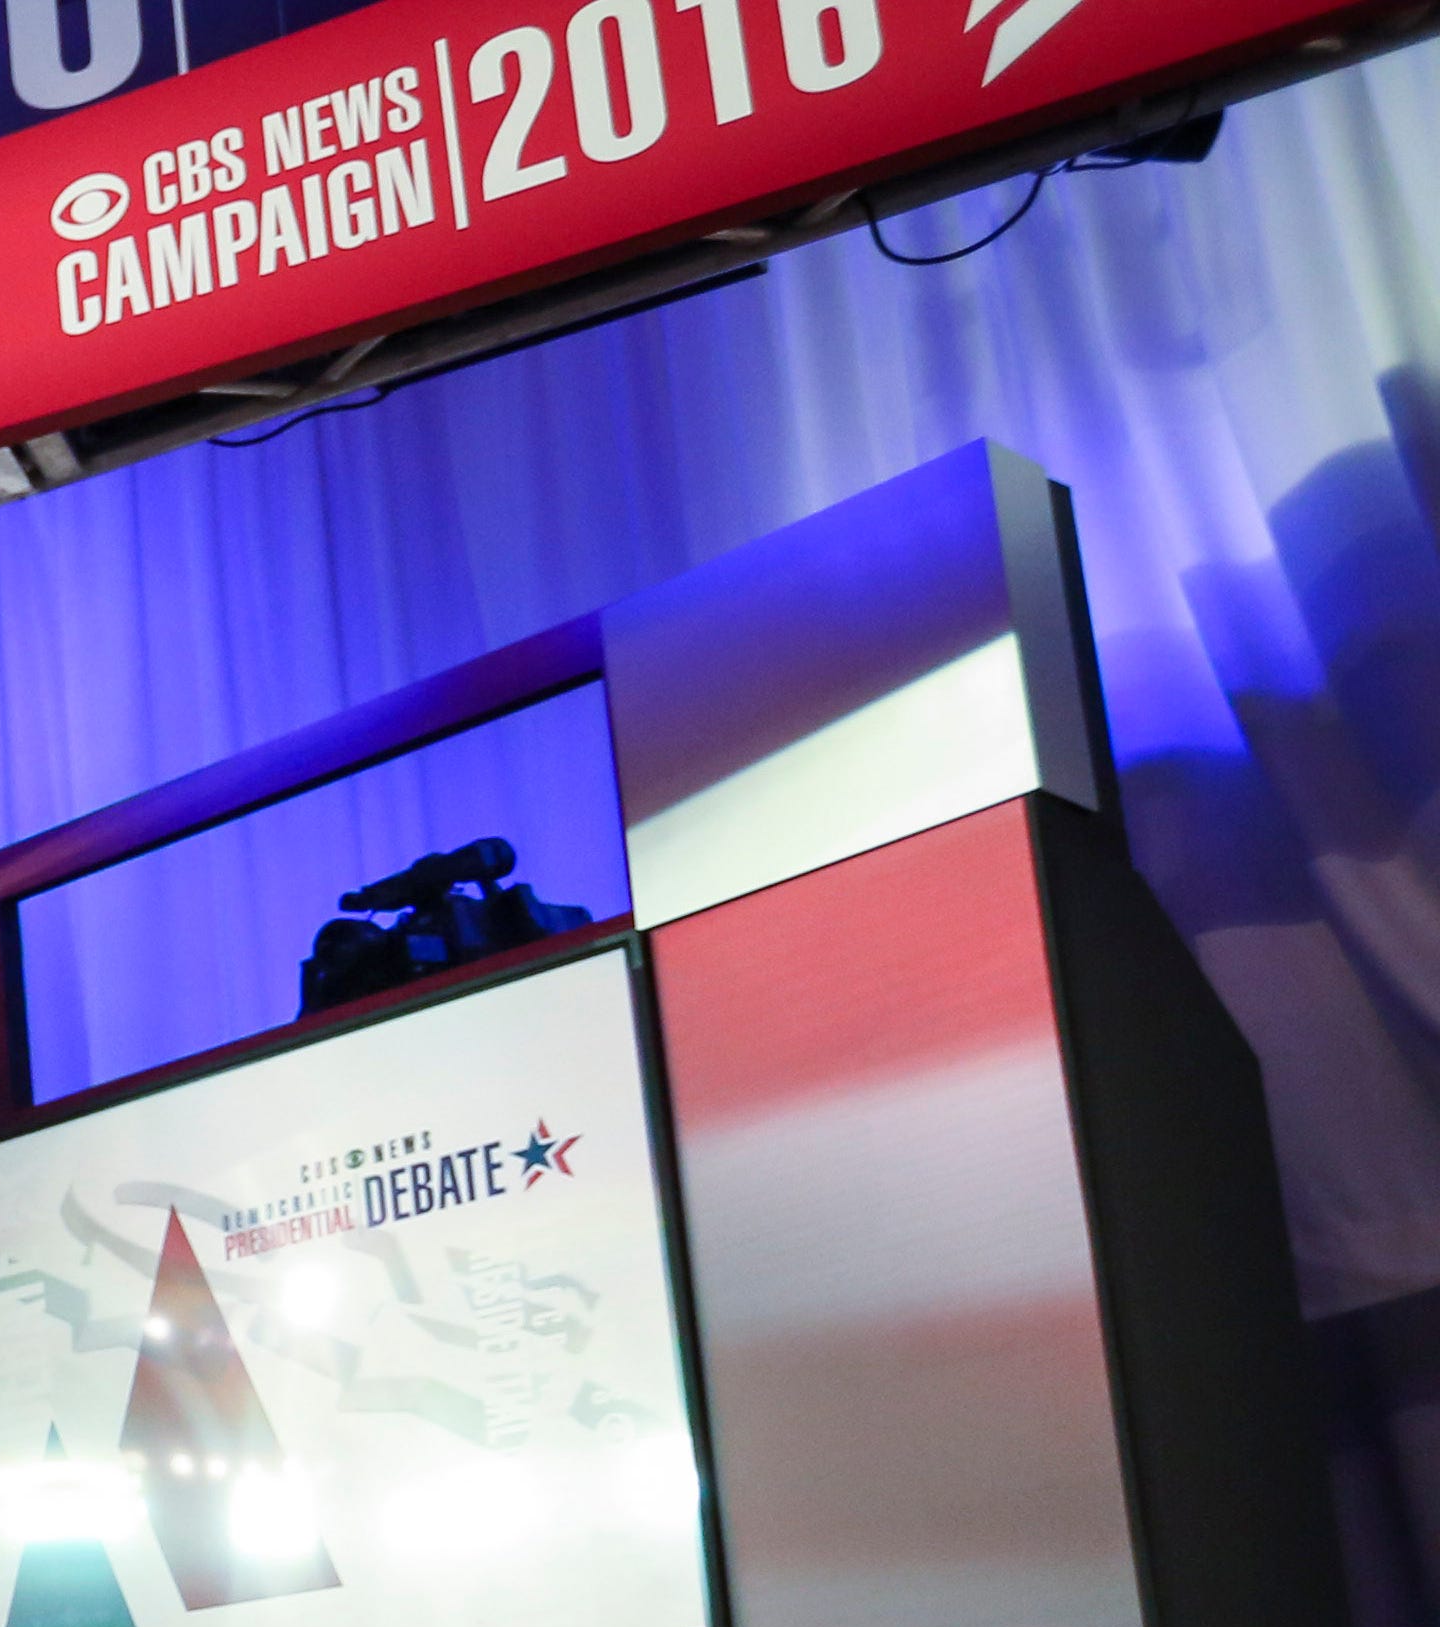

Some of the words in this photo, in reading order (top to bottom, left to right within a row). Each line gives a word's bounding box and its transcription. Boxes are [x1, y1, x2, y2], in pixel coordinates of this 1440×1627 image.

[141, 125, 246, 217] CBS
[262, 64, 423, 178] NEWS
[468, 0, 884, 203] 2016
[54, 138, 436, 338] CAMPAIGN
[301, 1157, 338, 1184] CBS
[373, 1130, 432, 1162] NEWS
[364, 1141, 505, 1229] DEBATE
[224, 1204, 356, 1261] PRESIDENTIAL
